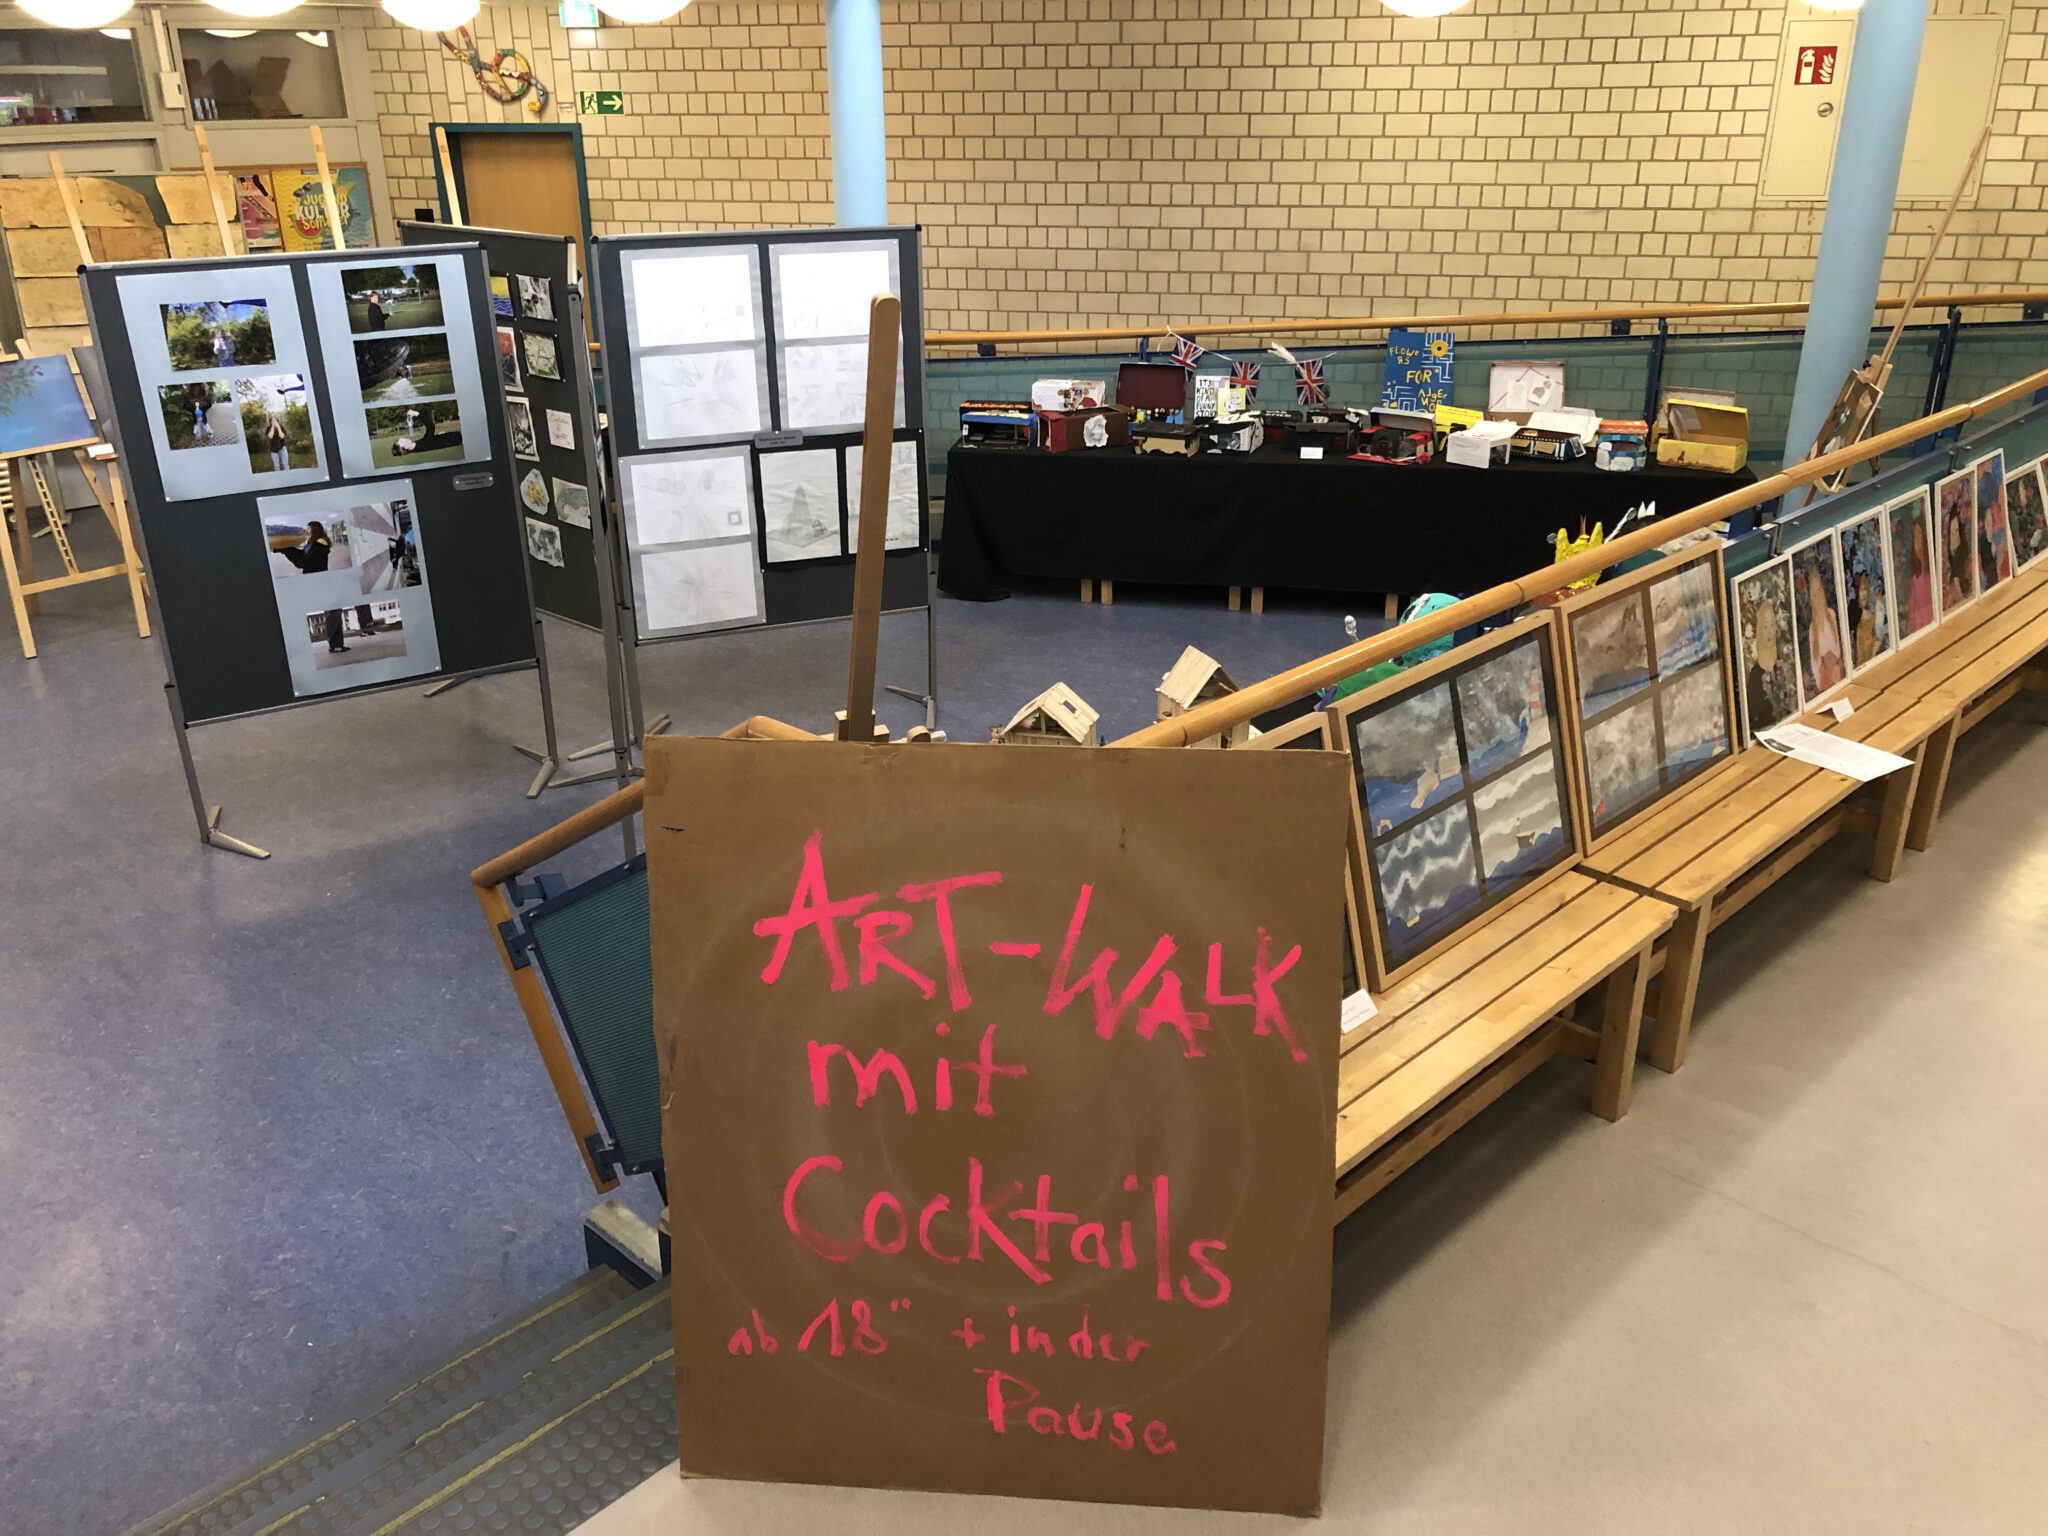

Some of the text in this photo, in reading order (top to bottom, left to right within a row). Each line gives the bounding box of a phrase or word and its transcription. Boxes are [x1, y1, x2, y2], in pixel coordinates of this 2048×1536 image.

[1196, 387, 1214, 395] KIND
[1196, 402, 1216, 410] FUNNY
[1406, 369, 1432, 384] FOR
[808, 1021, 1029, 1117] mit
[782, 1154, 1232, 1309] Cocktails
[727, 1308, 779, 1357] ab
[1007, 1304, 1054, 1359] in
[1067, 1303, 1152, 1362] der
[973, 1367, 1178, 1456] Pause
